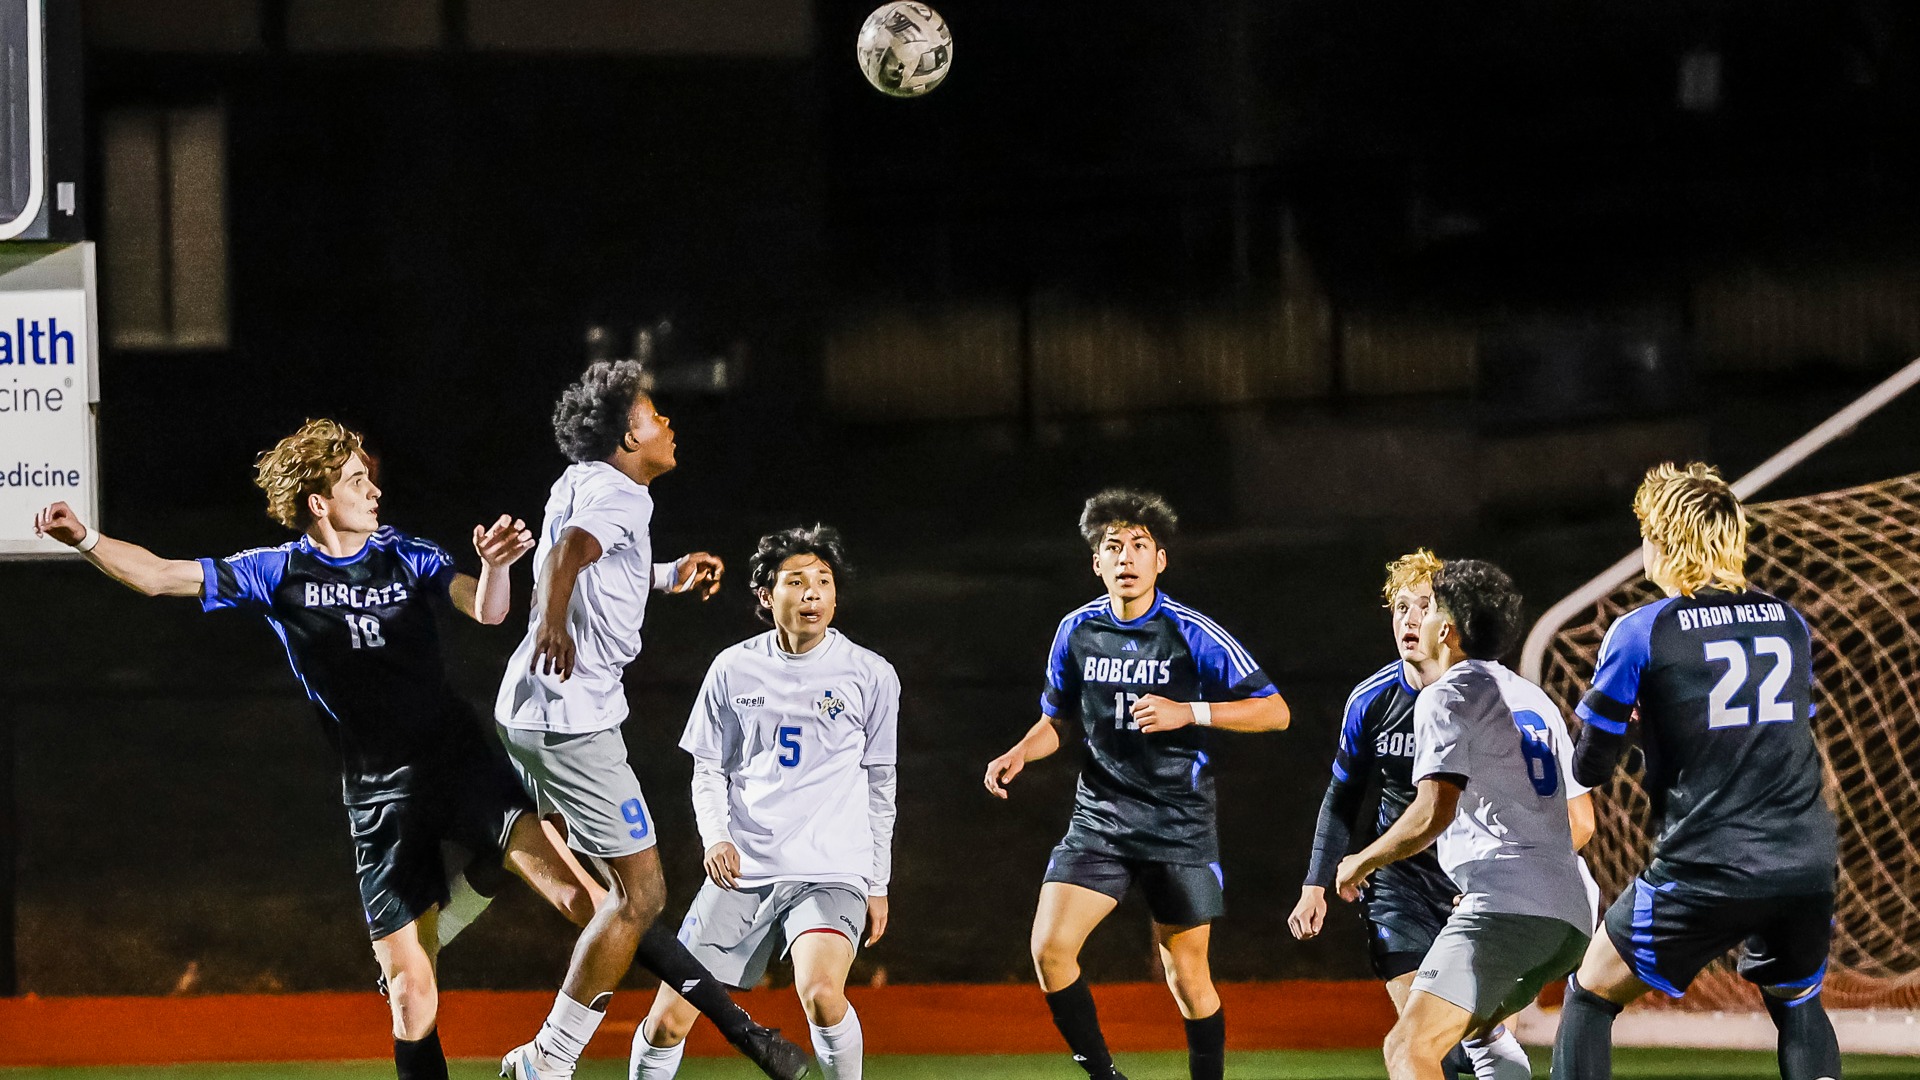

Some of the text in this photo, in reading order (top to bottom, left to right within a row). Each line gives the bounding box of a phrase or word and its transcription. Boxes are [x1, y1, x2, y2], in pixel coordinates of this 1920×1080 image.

[305, 582, 408, 608] BOBCATS
[1677, 602, 1786, 631] BYRON NELSON
[1083, 656, 1171, 685] BOBCATS
[1703, 635, 1794, 730] 22
[778, 726, 802, 768] 5
[1512, 708, 1558, 798] 6
[621, 798, 648, 839] 9
